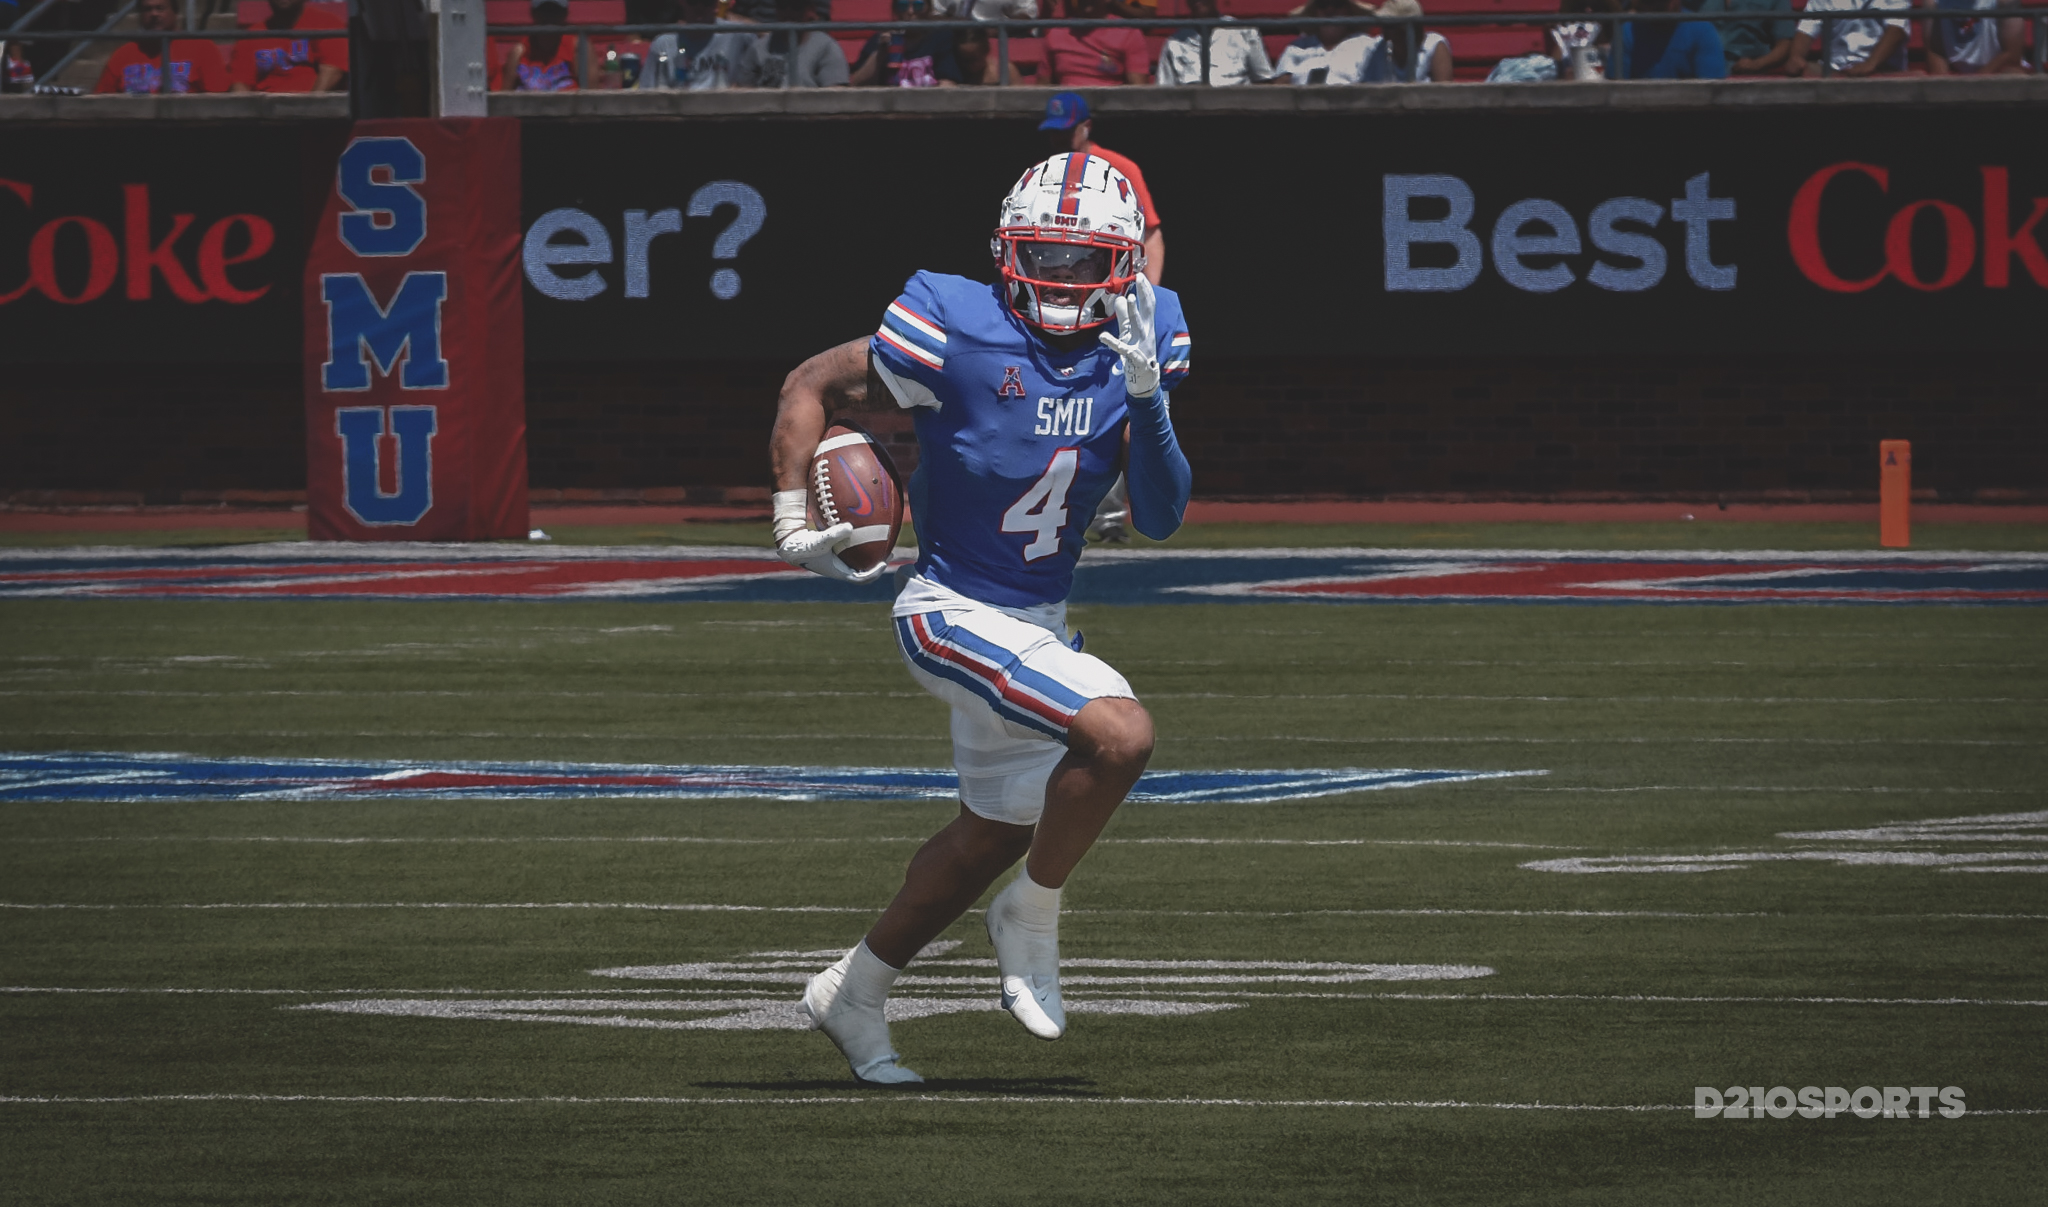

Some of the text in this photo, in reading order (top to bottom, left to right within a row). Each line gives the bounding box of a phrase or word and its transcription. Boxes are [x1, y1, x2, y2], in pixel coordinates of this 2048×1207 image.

[1054, 215, 1078, 227] SMU
[1382, 171, 1738, 292] Best
[320, 135, 450, 527] SMU
[1034, 396, 1094, 436] SMU
[1000, 446, 1080, 564] 4
